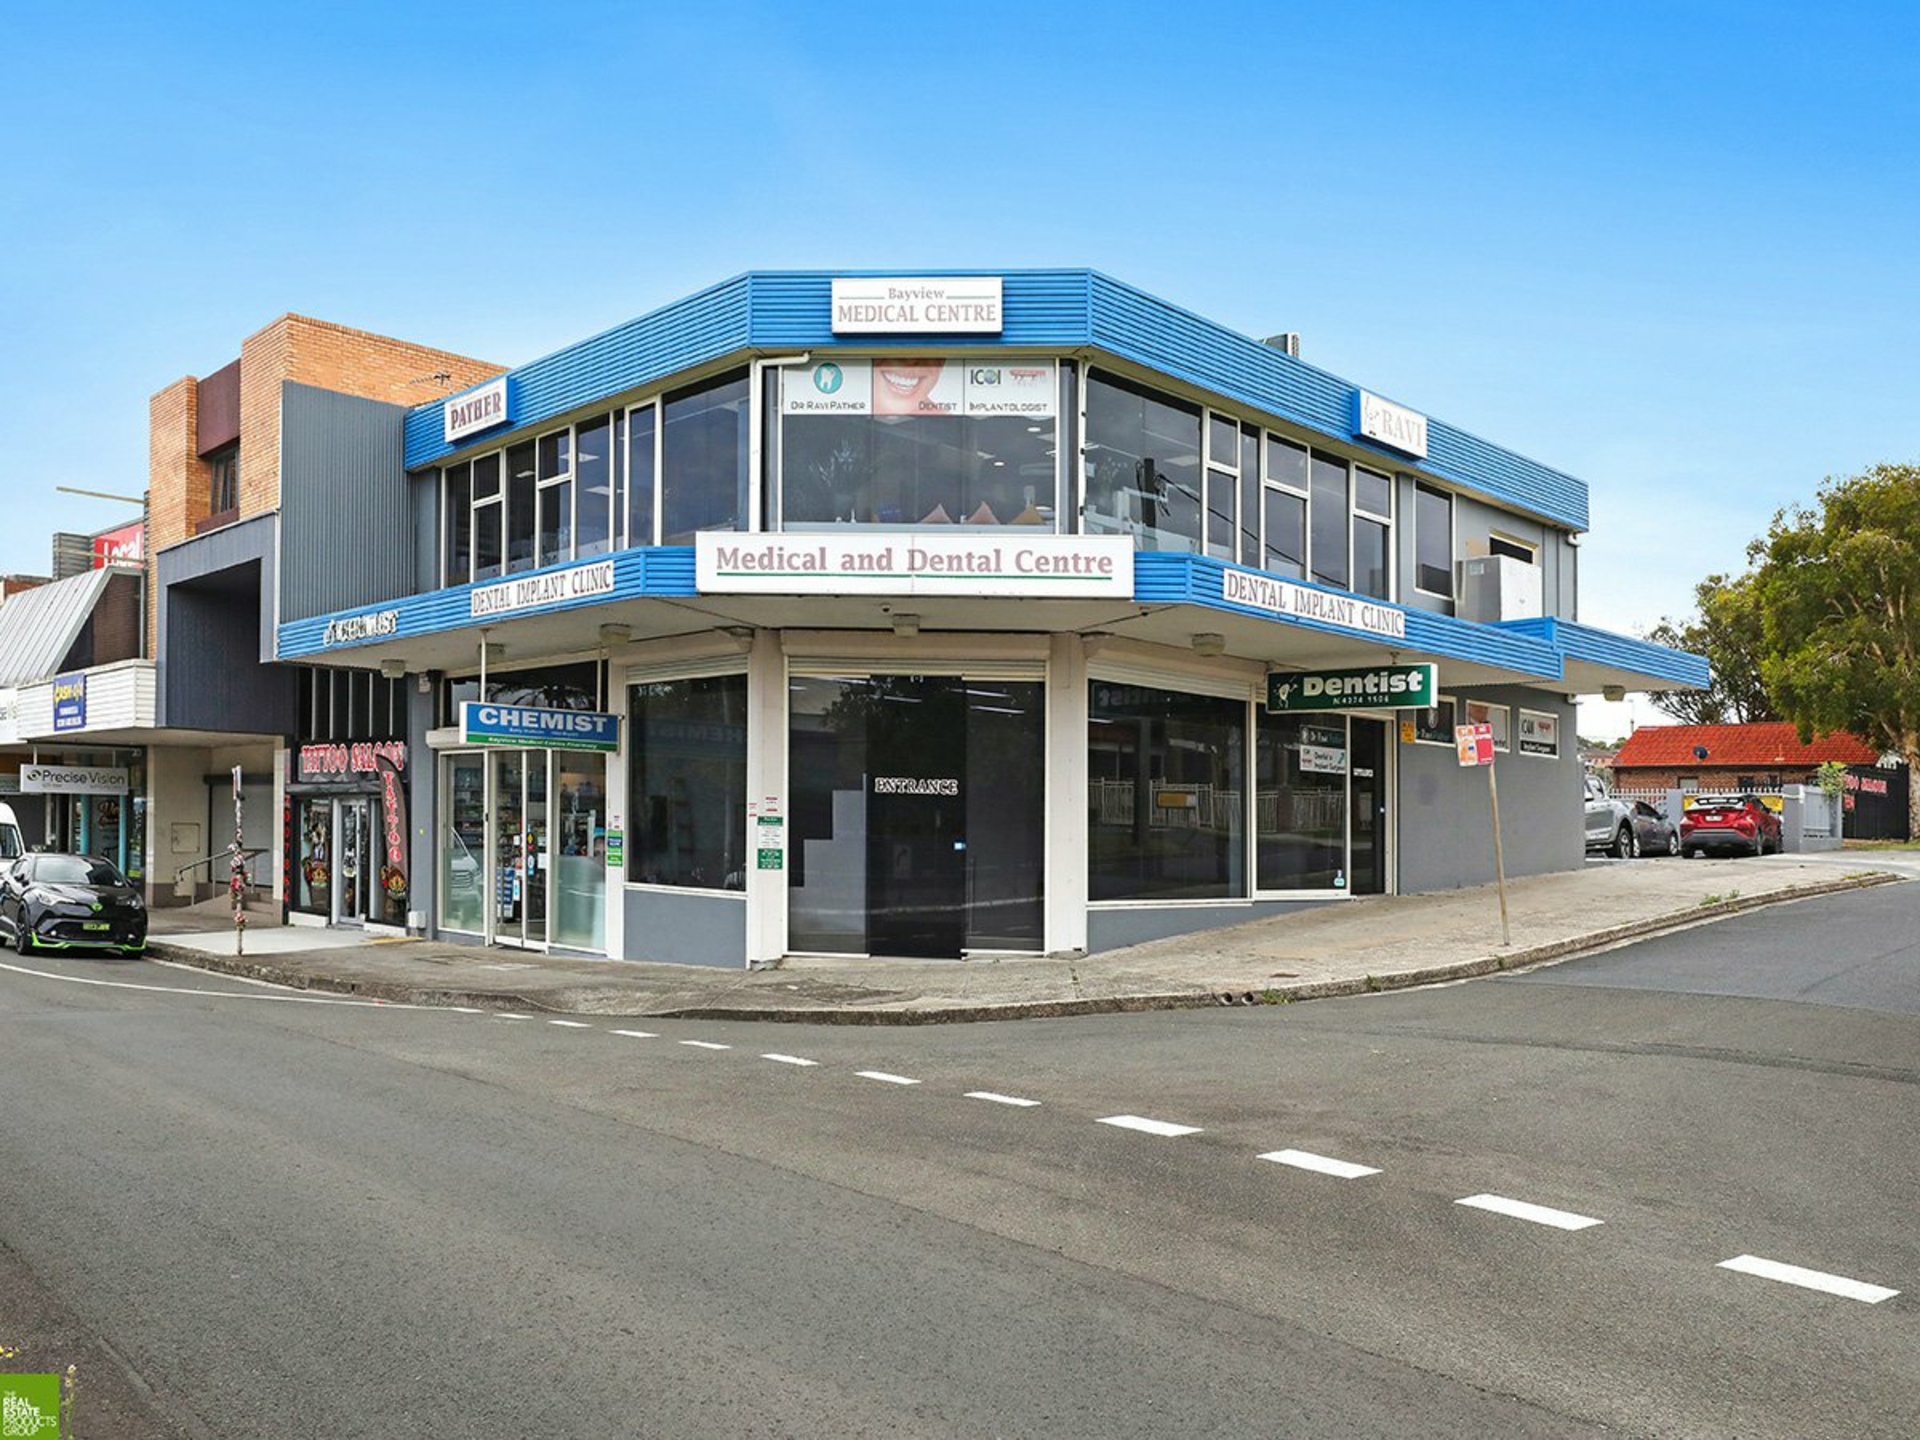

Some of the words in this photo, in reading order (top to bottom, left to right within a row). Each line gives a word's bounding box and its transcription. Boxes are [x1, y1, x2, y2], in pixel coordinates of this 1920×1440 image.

[888, 287, 945, 301] Bayview
[838, 304, 919, 323] MEDICAL
[924, 304, 997, 322] CENTRE
[451, 391, 502, 431] PATHER
[1381, 408, 1423, 449] RAVI
[716, 547, 827, 571] Medical
[841, 548, 893, 572] and
[907, 549, 1002, 573] Dental
[1015, 550, 1113, 574] Centre
[472, 585, 513, 615] DENTAL
[516, 575, 567, 606] IMPLANT
[571, 564, 613, 595] CLINIC
[1227, 572, 1287, 610] DENTAL
[1294, 587, 1356, 625] IMPLANT
[1361, 605, 1404, 637] CLINIC
[1303, 670, 1424, 697] Dentist
[478, 706, 608, 733] CHEMIST
[301, 743, 349, 774] TATTOO
[42, 769, 88, 784] Precise
[88, 771, 126, 785] Vision
[874, 777, 959, 796] ENTRANCE
